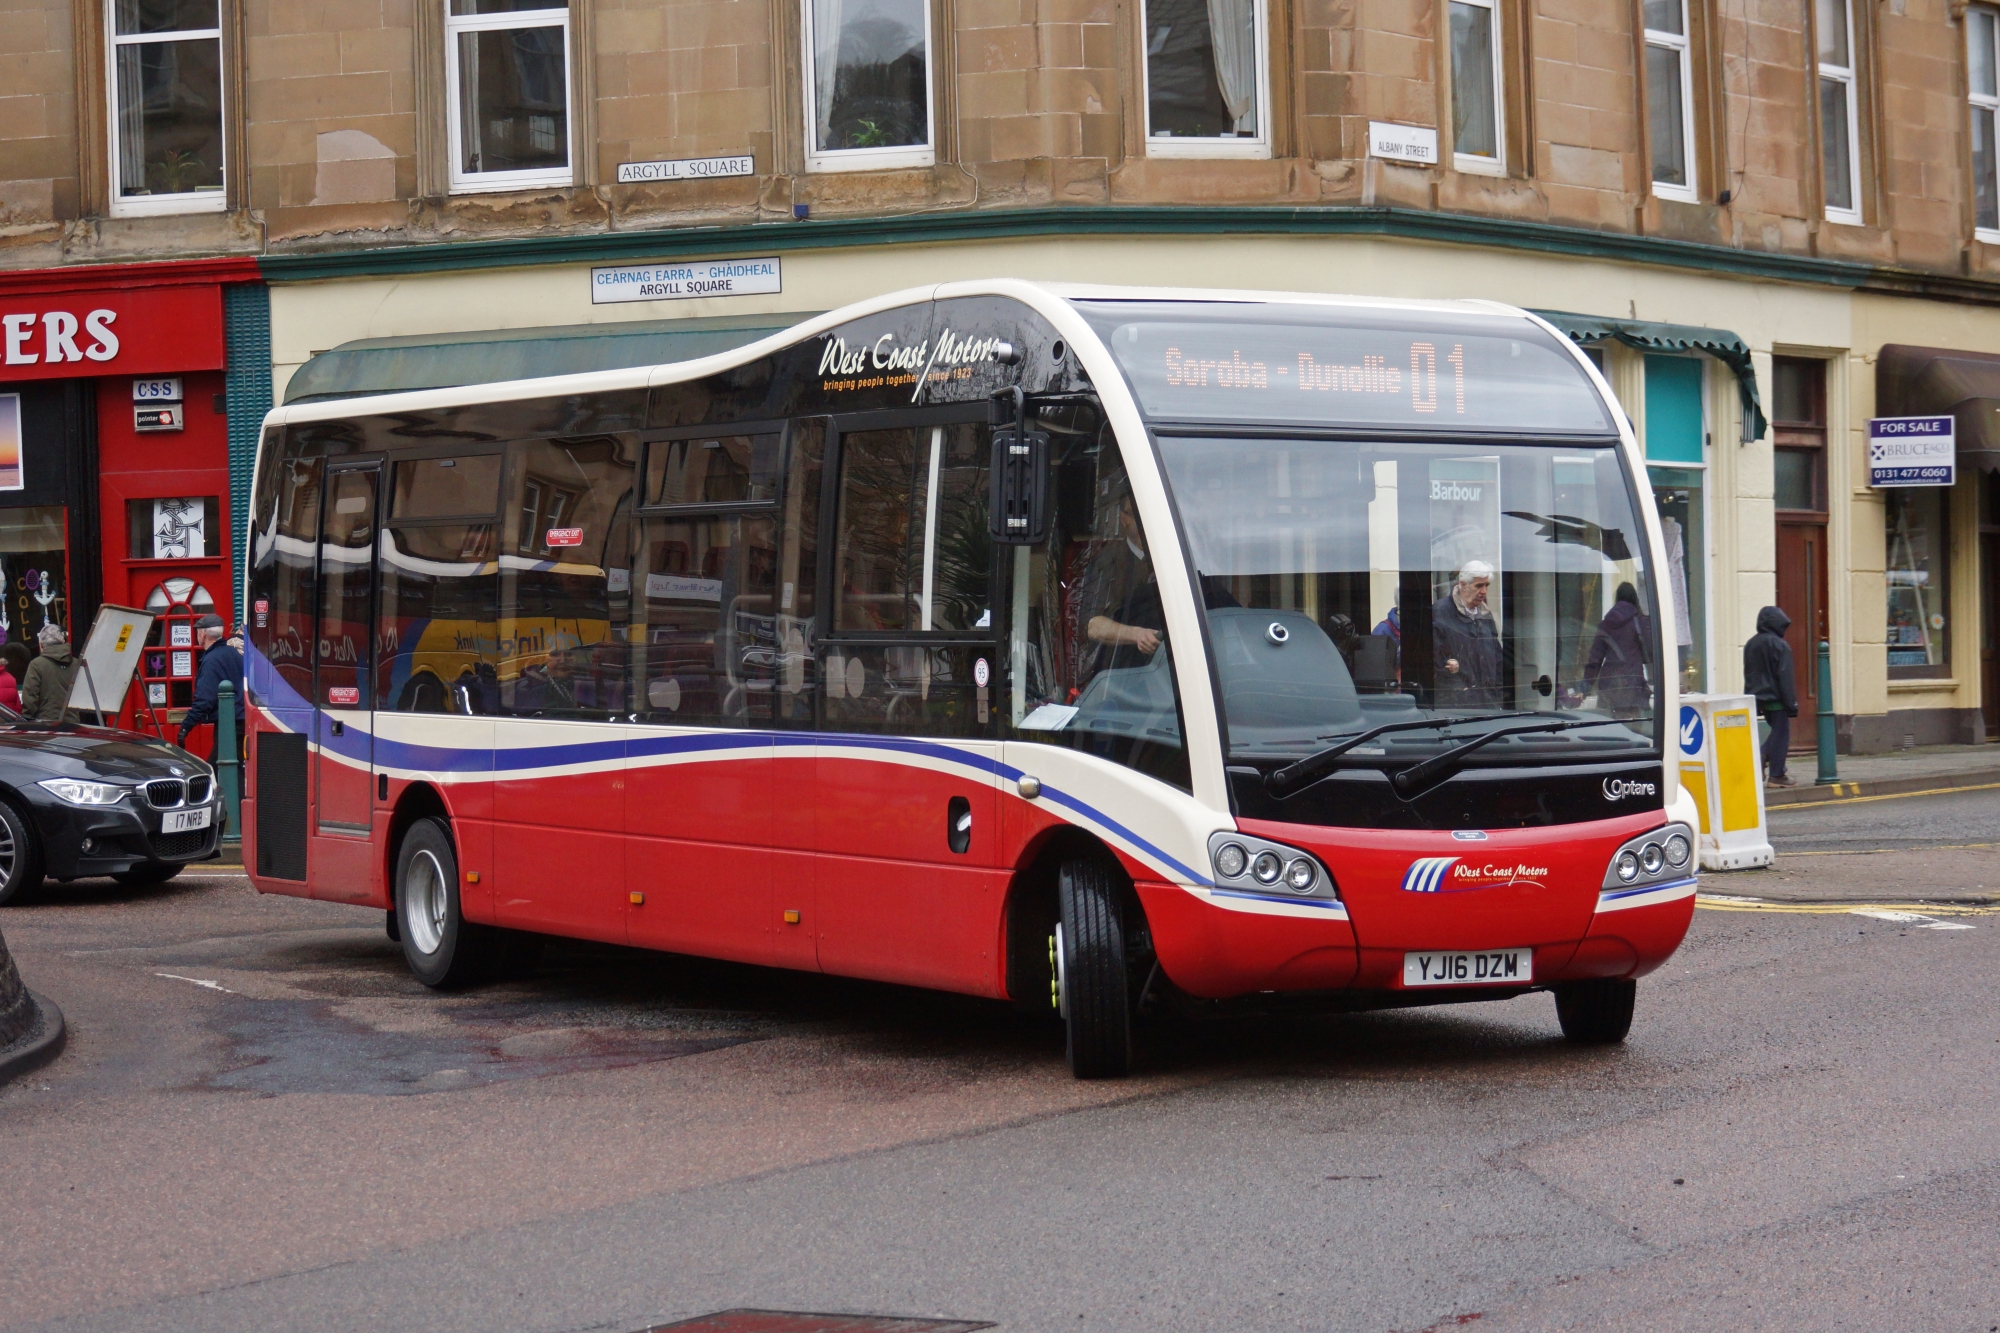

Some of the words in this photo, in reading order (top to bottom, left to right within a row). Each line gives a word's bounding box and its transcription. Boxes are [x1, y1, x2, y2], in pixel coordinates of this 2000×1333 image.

[1379, 141, 1403, 154] ALBANY
[1406, 145, 1429, 157] STREET
[622, 164, 680, 180] ARGYLL
[689, 159, 749, 177] SQUARE
[597, 269, 651, 285] CEÀRNAG
[656, 268, 694, 282] EARRA
[709, 262, 775, 279] GHÀIDHEAL
[639, 283, 682, 296] ARGYLL
[687, 279, 733, 295] SQUARE
[0, 309, 119, 364] ERS
[818, 337, 867, 376] West
[872, 333, 928, 370] Coast
[911, 328, 1000, 403] Motors
[823, 374, 856, 391] bringing
[858, 375, 884, 390] people
[886, 373, 919, 388] together
[927, 370, 950, 382] since
[953, 367, 972, 379] 1923
[1166, 347, 1267, 389] Soroba
[1298, 353, 1401, 393] Dunollie
[1410, 342, 1465, 414] 01
[138, 415, 158, 424] pointer
[1880, 423, 1906, 433] FOR
[1908, 422, 1940, 432] SALE
[1874, 468, 1898, 479] 0131
[1900, 468, 1920, 478] 477
[1921, 468, 1946, 477] 6060
[1431, 480, 1482, 502] Barbour
[977, 667, 986, 679] 95
[1611, 779, 1656, 799] Optare
[175, 813, 185, 829] 17
[187, 811, 203, 828] NRB
[1454, 865, 1480, 877] West
[1483, 864, 1512, 877] Coast
[1508, 863, 1548, 887] Motors
[1419, 955, 1468, 980] YJ16
[1475, 953, 1517, 979] DZM
